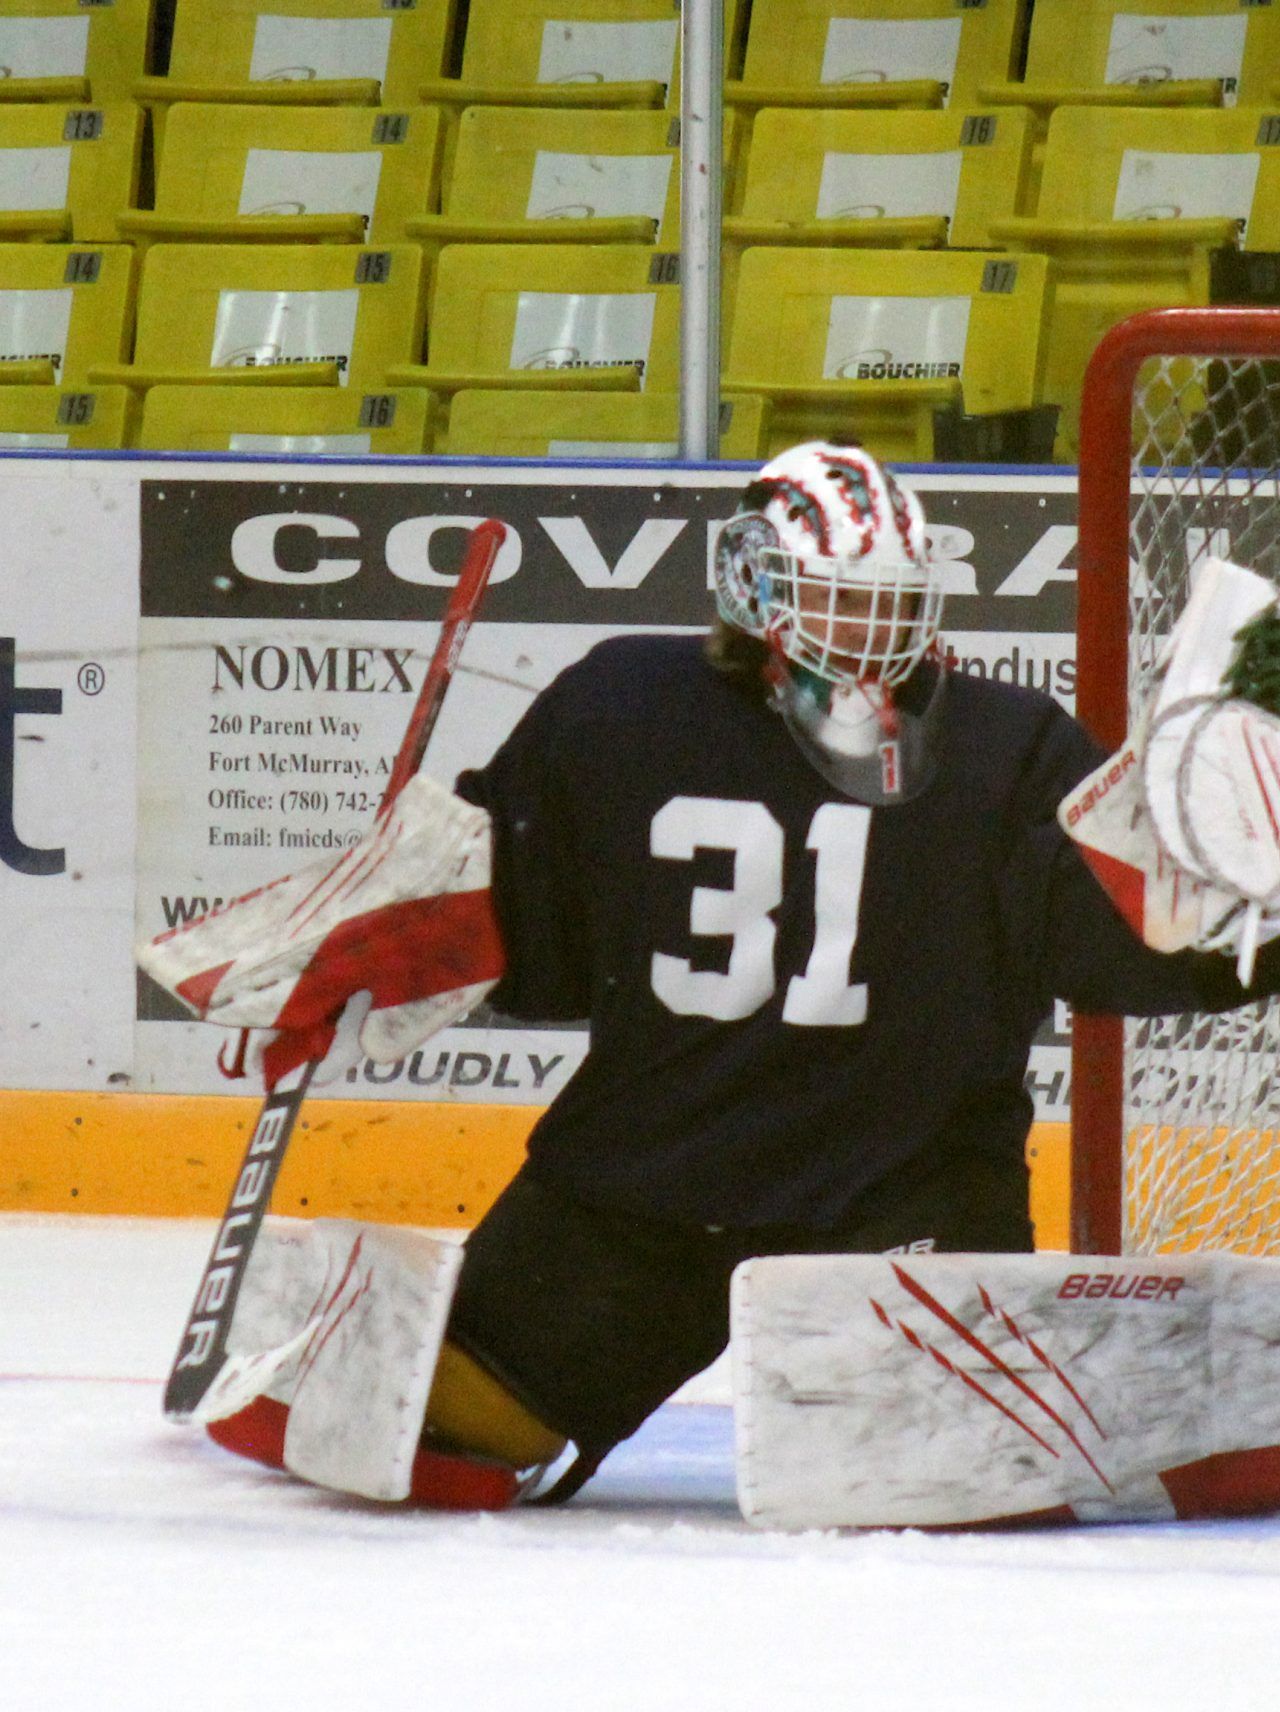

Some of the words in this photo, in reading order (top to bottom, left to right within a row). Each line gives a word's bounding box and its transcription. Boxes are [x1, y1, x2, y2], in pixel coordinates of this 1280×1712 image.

[857, 361, 962, 380] BOUCHIER
[212, 644, 417, 693] NOMEX
[208, 714, 242, 735] 260
[249, 715, 313, 737] Parent
[319, 716, 363, 742] Way
[208, 751, 251, 773] Fort
[257, 752, 370, 779] McMurray,
[207, 788, 273, 810] Office:
[279, 789, 329, 814] (780)
[208, 826, 272, 847] Email:
[650, 795, 873, 1026] 31
[345, 1050, 566, 1089] OUDLY
